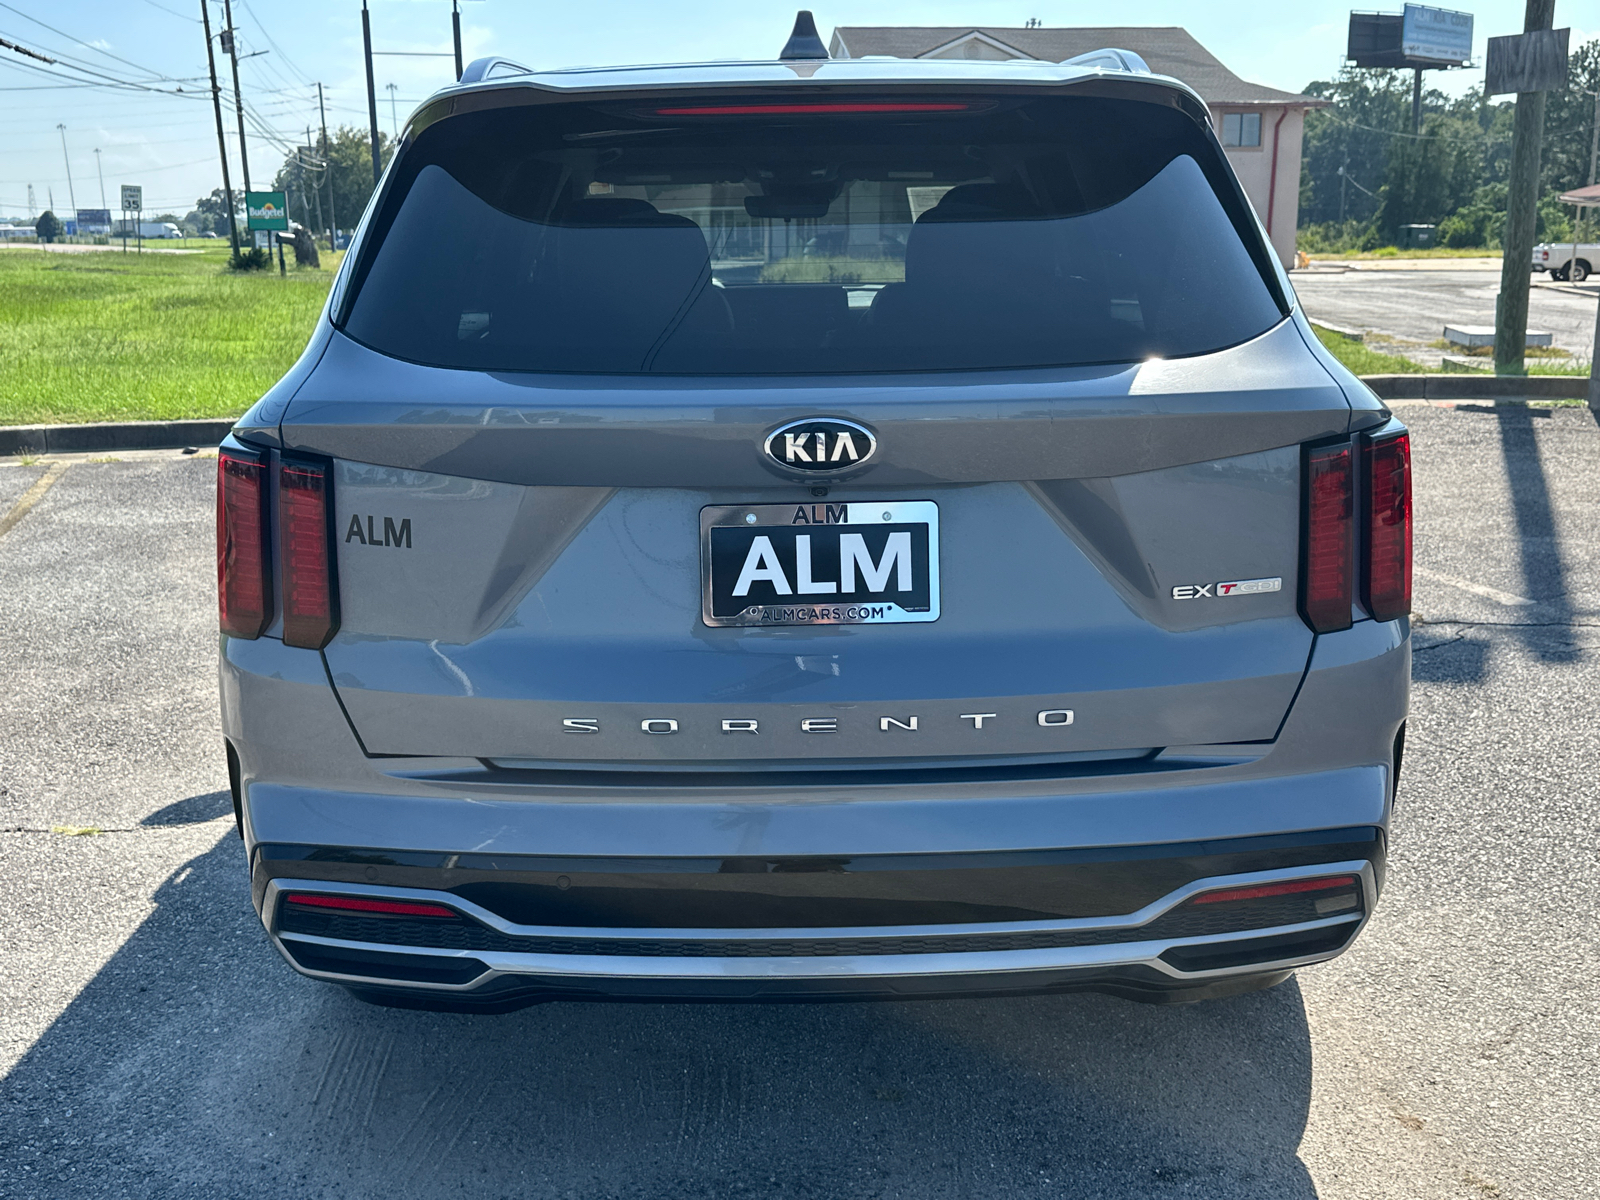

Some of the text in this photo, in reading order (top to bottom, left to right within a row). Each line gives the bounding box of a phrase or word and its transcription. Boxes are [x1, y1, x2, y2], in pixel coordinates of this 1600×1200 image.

[124, 199, 140, 209] 35
[249, 206, 284, 219] Budgetel
[784, 432, 859, 462] KIA
[791, 504, 848, 524] ALM
[345, 513, 412, 548] ALM
[731, 532, 913, 597] ALM
[1172, 583, 1213, 600] EX
[760, 606, 884, 622] ALMCARS.COM
[563, 709, 1075, 735] SORENTO
